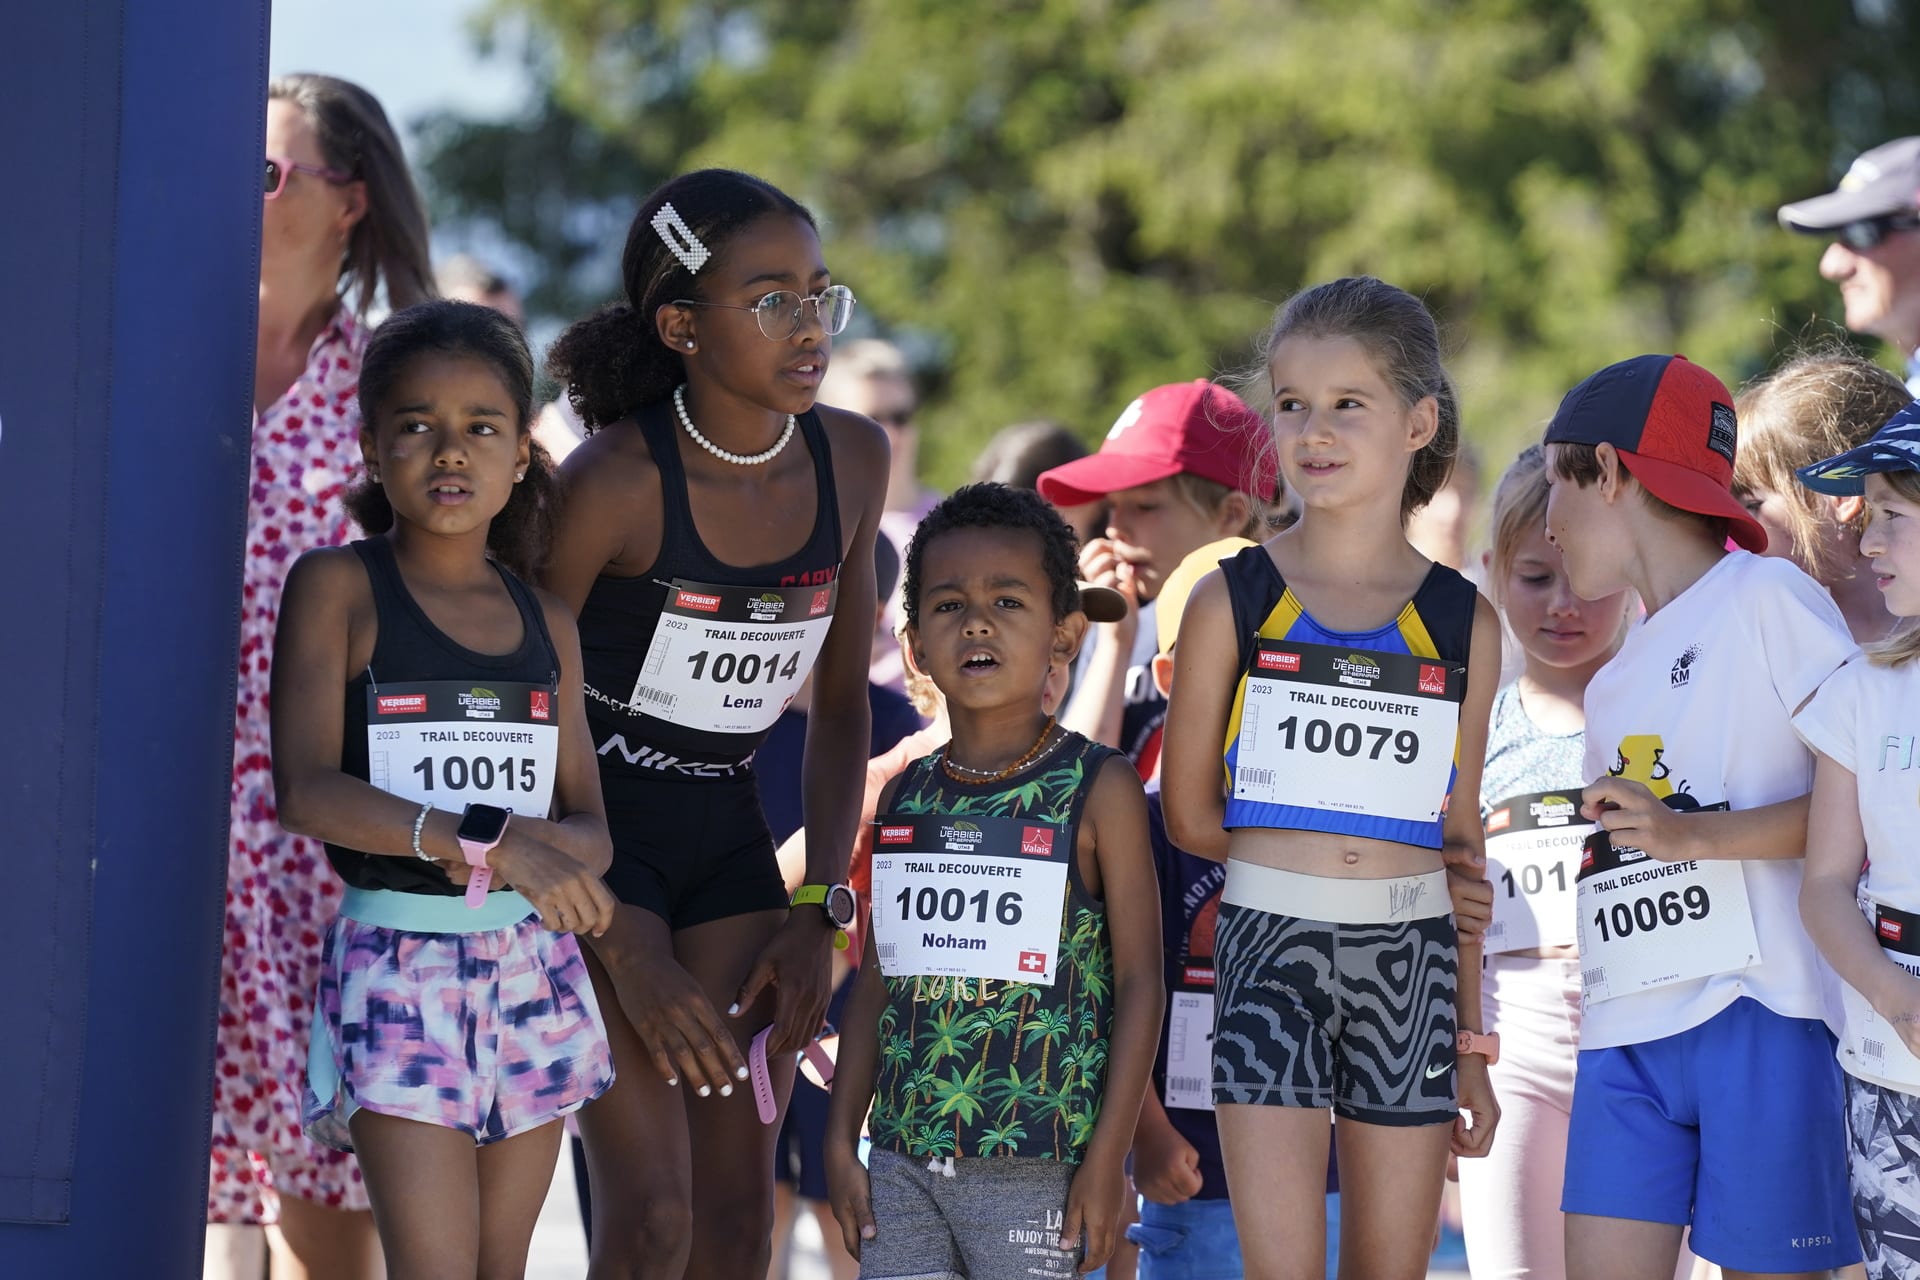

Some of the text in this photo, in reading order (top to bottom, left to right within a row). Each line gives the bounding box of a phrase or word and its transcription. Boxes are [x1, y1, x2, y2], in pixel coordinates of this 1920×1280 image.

[680, 593, 716, 605] VERBIER
[665, 620, 688, 631] 2023
[704, 629, 806, 642] TRAIL DECOUVERTE
[1261, 653, 1296, 664] VERBIER
[687, 650, 801, 684] 10014
[1333, 663, 1380, 674] VERBIER
[1671, 669, 1689, 684] KM
[1252, 684, 1273, 694] 2023
[1420, 682, 1443, 692] Valais
[380, 697, 422, 707] VERBIER
[723, 694, 763, 709] Lena
[1289, 691, 1419, 717] TRAIL DECOUVERTE
[377, 731, 400, 740] 2023
[420, 731, 533, 744] TRAIL DECOUVERTE
[1278, 715, 1420, 764] 10079
[413, 756, 536, 792] 10015
[882, 829, 910, 837] VERBIER
[940, 830, 983, 839] VERBIER
[1023, 843, 1049, 854] Valais
[876, 860, 892, 870] 2023
[904, 862, 1022, 878] TRAIL DECOUVERTE
[1501, 861, 1581, 898] 101
[1593, 860, 1697, 894] TRAIL DECOUVERTE
[896, 887, 1023, 926] 10016
[1594, 885, 1710, 942] 10069
[922, 933, 987, 950] Noham
[1009, 1230, 1043, 1244] ENJOY
[1046, 1232, 1060, 1248] THE
[1792, 1236, 1832, 1248] KIPSTA
